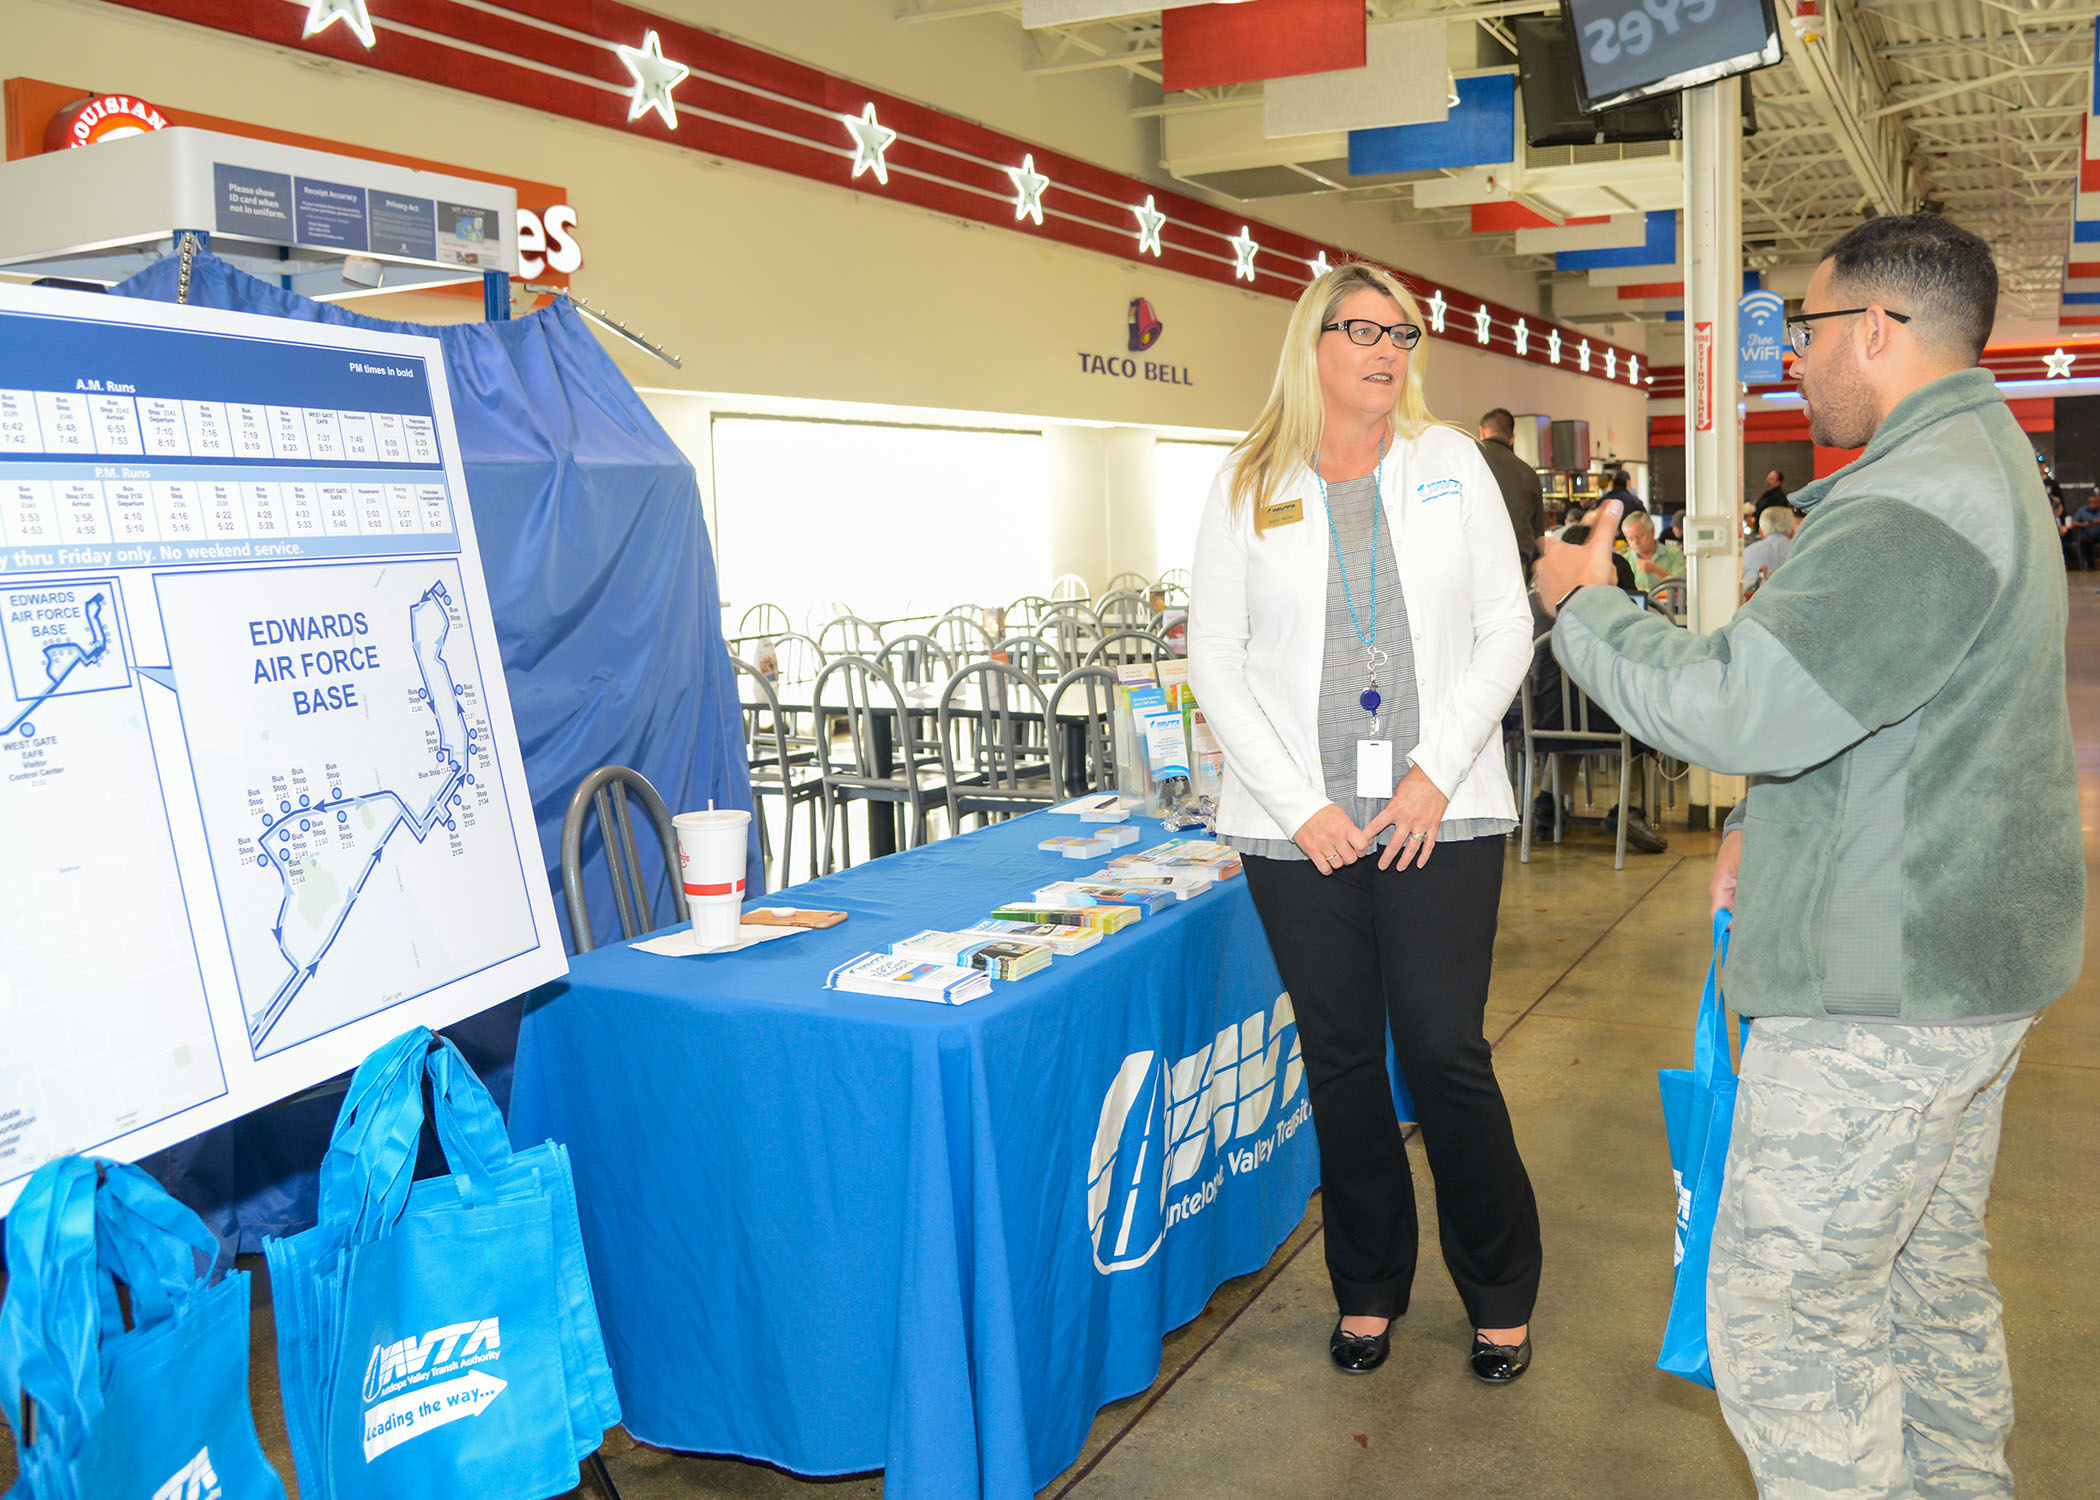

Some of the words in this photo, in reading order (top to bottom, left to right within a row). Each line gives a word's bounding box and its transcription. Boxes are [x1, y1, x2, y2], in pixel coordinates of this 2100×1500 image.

[229, 183, 254, 195] Please
[255, 187, 275, 198] show
[304, 186, 328, 198] Receipt
[329, 191, 358, 203] Accuracy
[229, 193, 239, 202] ID
[240, 195, 257, 205] card
[258, 198, 279, 208] when
[386, 200, 408, 212] Privacy
[409, 203, 419, 213] Act
[229, 204, 243, 213] not
[245, 205, 252, 214] in
[253, 207, 287, 219] uniform.
[517, 205, 581, 279] es
[1747, 334, 1774, 346] Free
[1741, 346, 1780, 361] WiFi
[349, 362, 363, 373] PM
[364, 364, 386, 376] times
[388, 366, 395, 376] in
[396, 367, 414, 378] bold
[1077, 352, 1137, 379] TACO
[1144, 361, 1194, 386] BELL
[76, 378, 104, 391] A.M.
[106, 381, 136, 393] Runs
[94, 467, 120, 478] P.M.
[122, 467, 151, 479] Runs
[14, 551, 54, 567] thru
[58, 548, 112, 567] Friday
[117, 546, 156, 563] only.
[160, 545, 182, 560] No
[186, 542, 250, 559] weekend
[254, 541, 304, 556] service.
[10, 592, 75, 606] EDWARDS
[11, 609, 33, 622] AIR
[37, 607, 80, 620] FORCE
[32, 624, 67, 637] BASE
[249, 612, 368, 646] EDWARDS
[254, 656, 296, 684] AIR
[301, 645, 380, 677] FORCE
[293, 683, 358, 715] BASE
[3, 740, 30, 751] WEST
[33, 736, 58, 747] GATE
[23, 759, 47, 769] Visitor
[9, 770, 38, 782] Control
[40, 767, 64, 777] Center
[292, 776, 307, 784] Stop
[326, 772, 340, 780] Stop
[429, 770, 440, 778] Stop
[273, 784, 288, 792] Stop
[248, 798, 264, 806] Stop
[239, 846, 254, 854] Stop
[290, 868, 304, 876] Stop
[1228, 1134, 1275, 1176] Valley
[408, 1371, 431, 1385] Valley
[431, 1362, 459, 1377] Transit
[460, 1350, 501, 1369] Authority
[367, 1410, 414, 1442] Leading
[418, 1400, 442, 1418] the
[446, 1388, 495, 1408] way...
